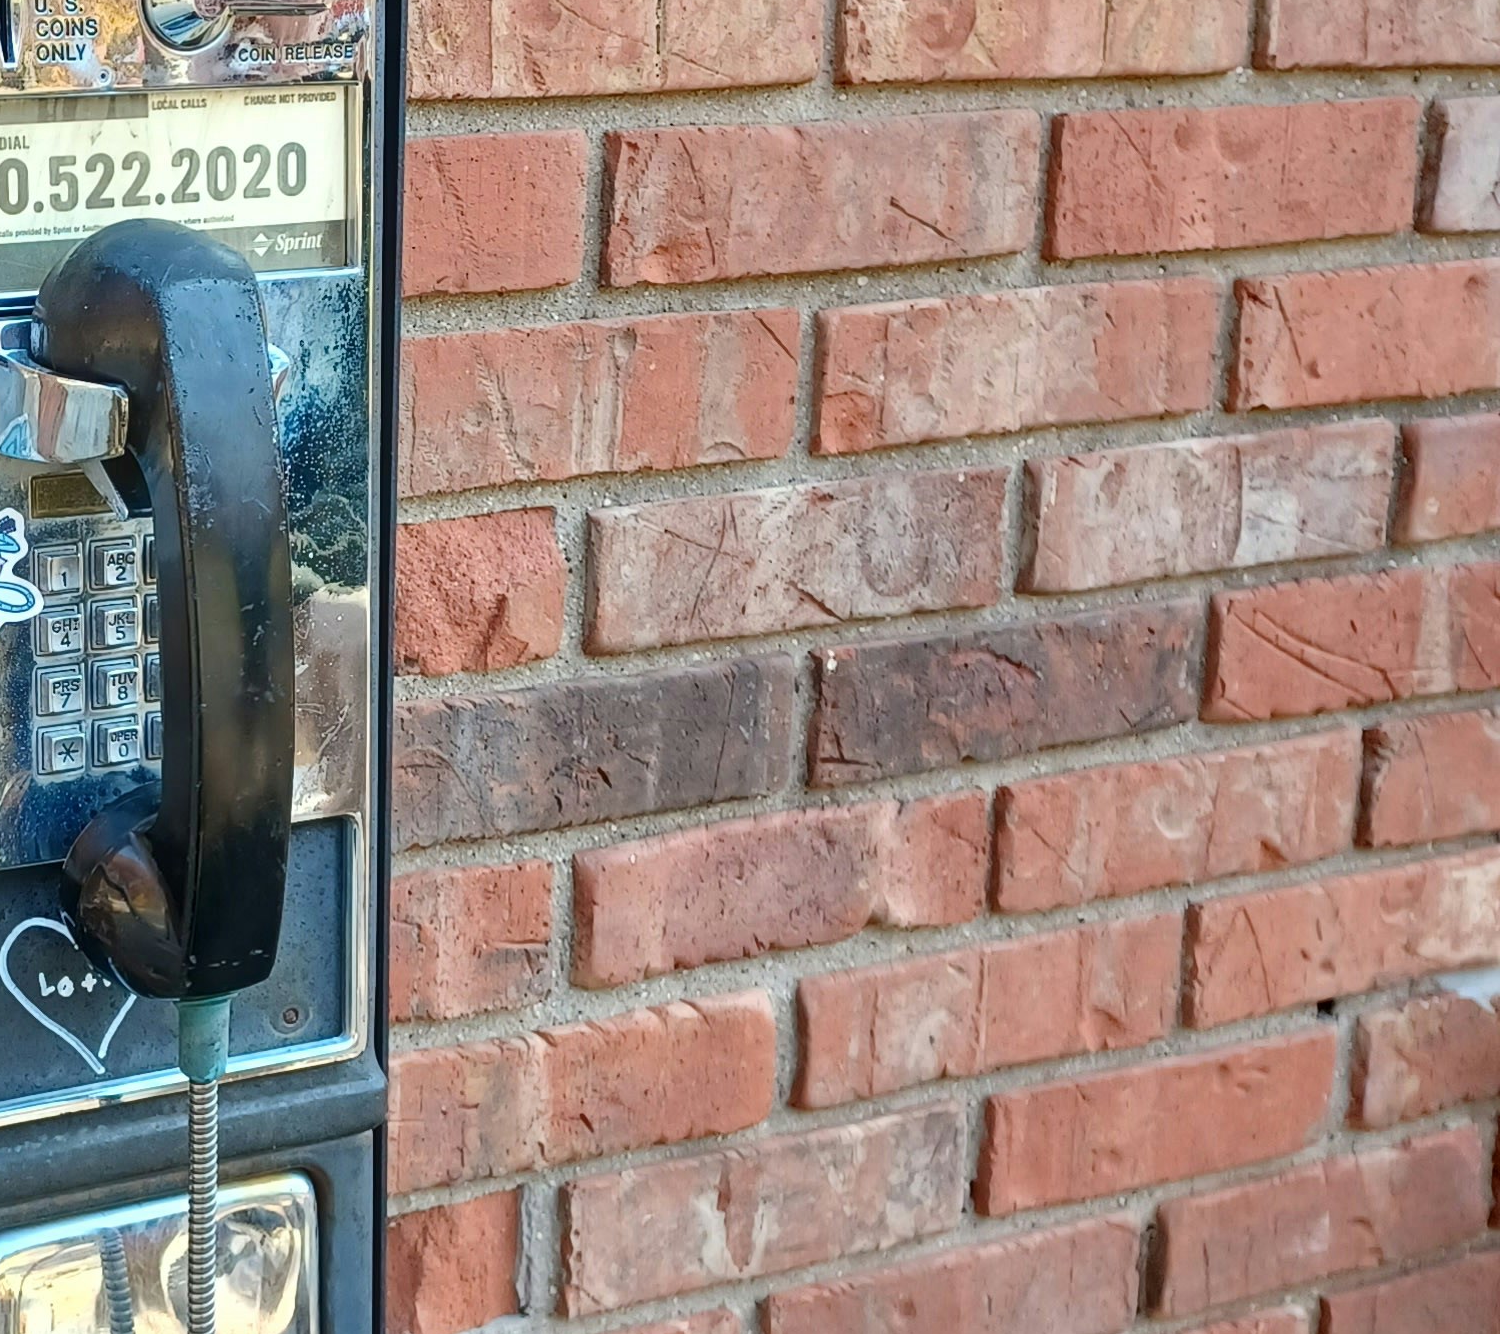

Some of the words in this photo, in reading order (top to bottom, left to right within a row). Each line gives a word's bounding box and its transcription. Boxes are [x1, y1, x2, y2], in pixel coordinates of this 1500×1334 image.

[35, 18, 99, 38] COINS
[35, 43, 87, 62] ONLY
[238, 48, 277, 63] COIN
[285, 44, 354, 61] RELEASE
[151, 97, 179, 110] LOCAL
[180, 97, 208, 109] CALLS
[243, 94, 277, 106] CHANGE
[279, 93, 296, 104] NOT
[297, 91, 337, 103] PROVIDED
[274, 231, 323, 255] Sprint
[106, 551, 136, 567] ABC
[60, 571, 68, 587] 1
[115, 566, 128, 582] 2
[51, 618, 80, 633] GHI
[108, 612, 136, 627] JKL
[60, 632, 72, 648] 4
[115, 625, 127, 641] 5
[52, 680, 81, 695] PRS
[109, 672, 138, 687] TUV
[60, 692, 72, 709] 7
[117, 685, 129, 701] 8
[110, 729, 139, 743] OPER
[118, 742, 130, 758] 0
